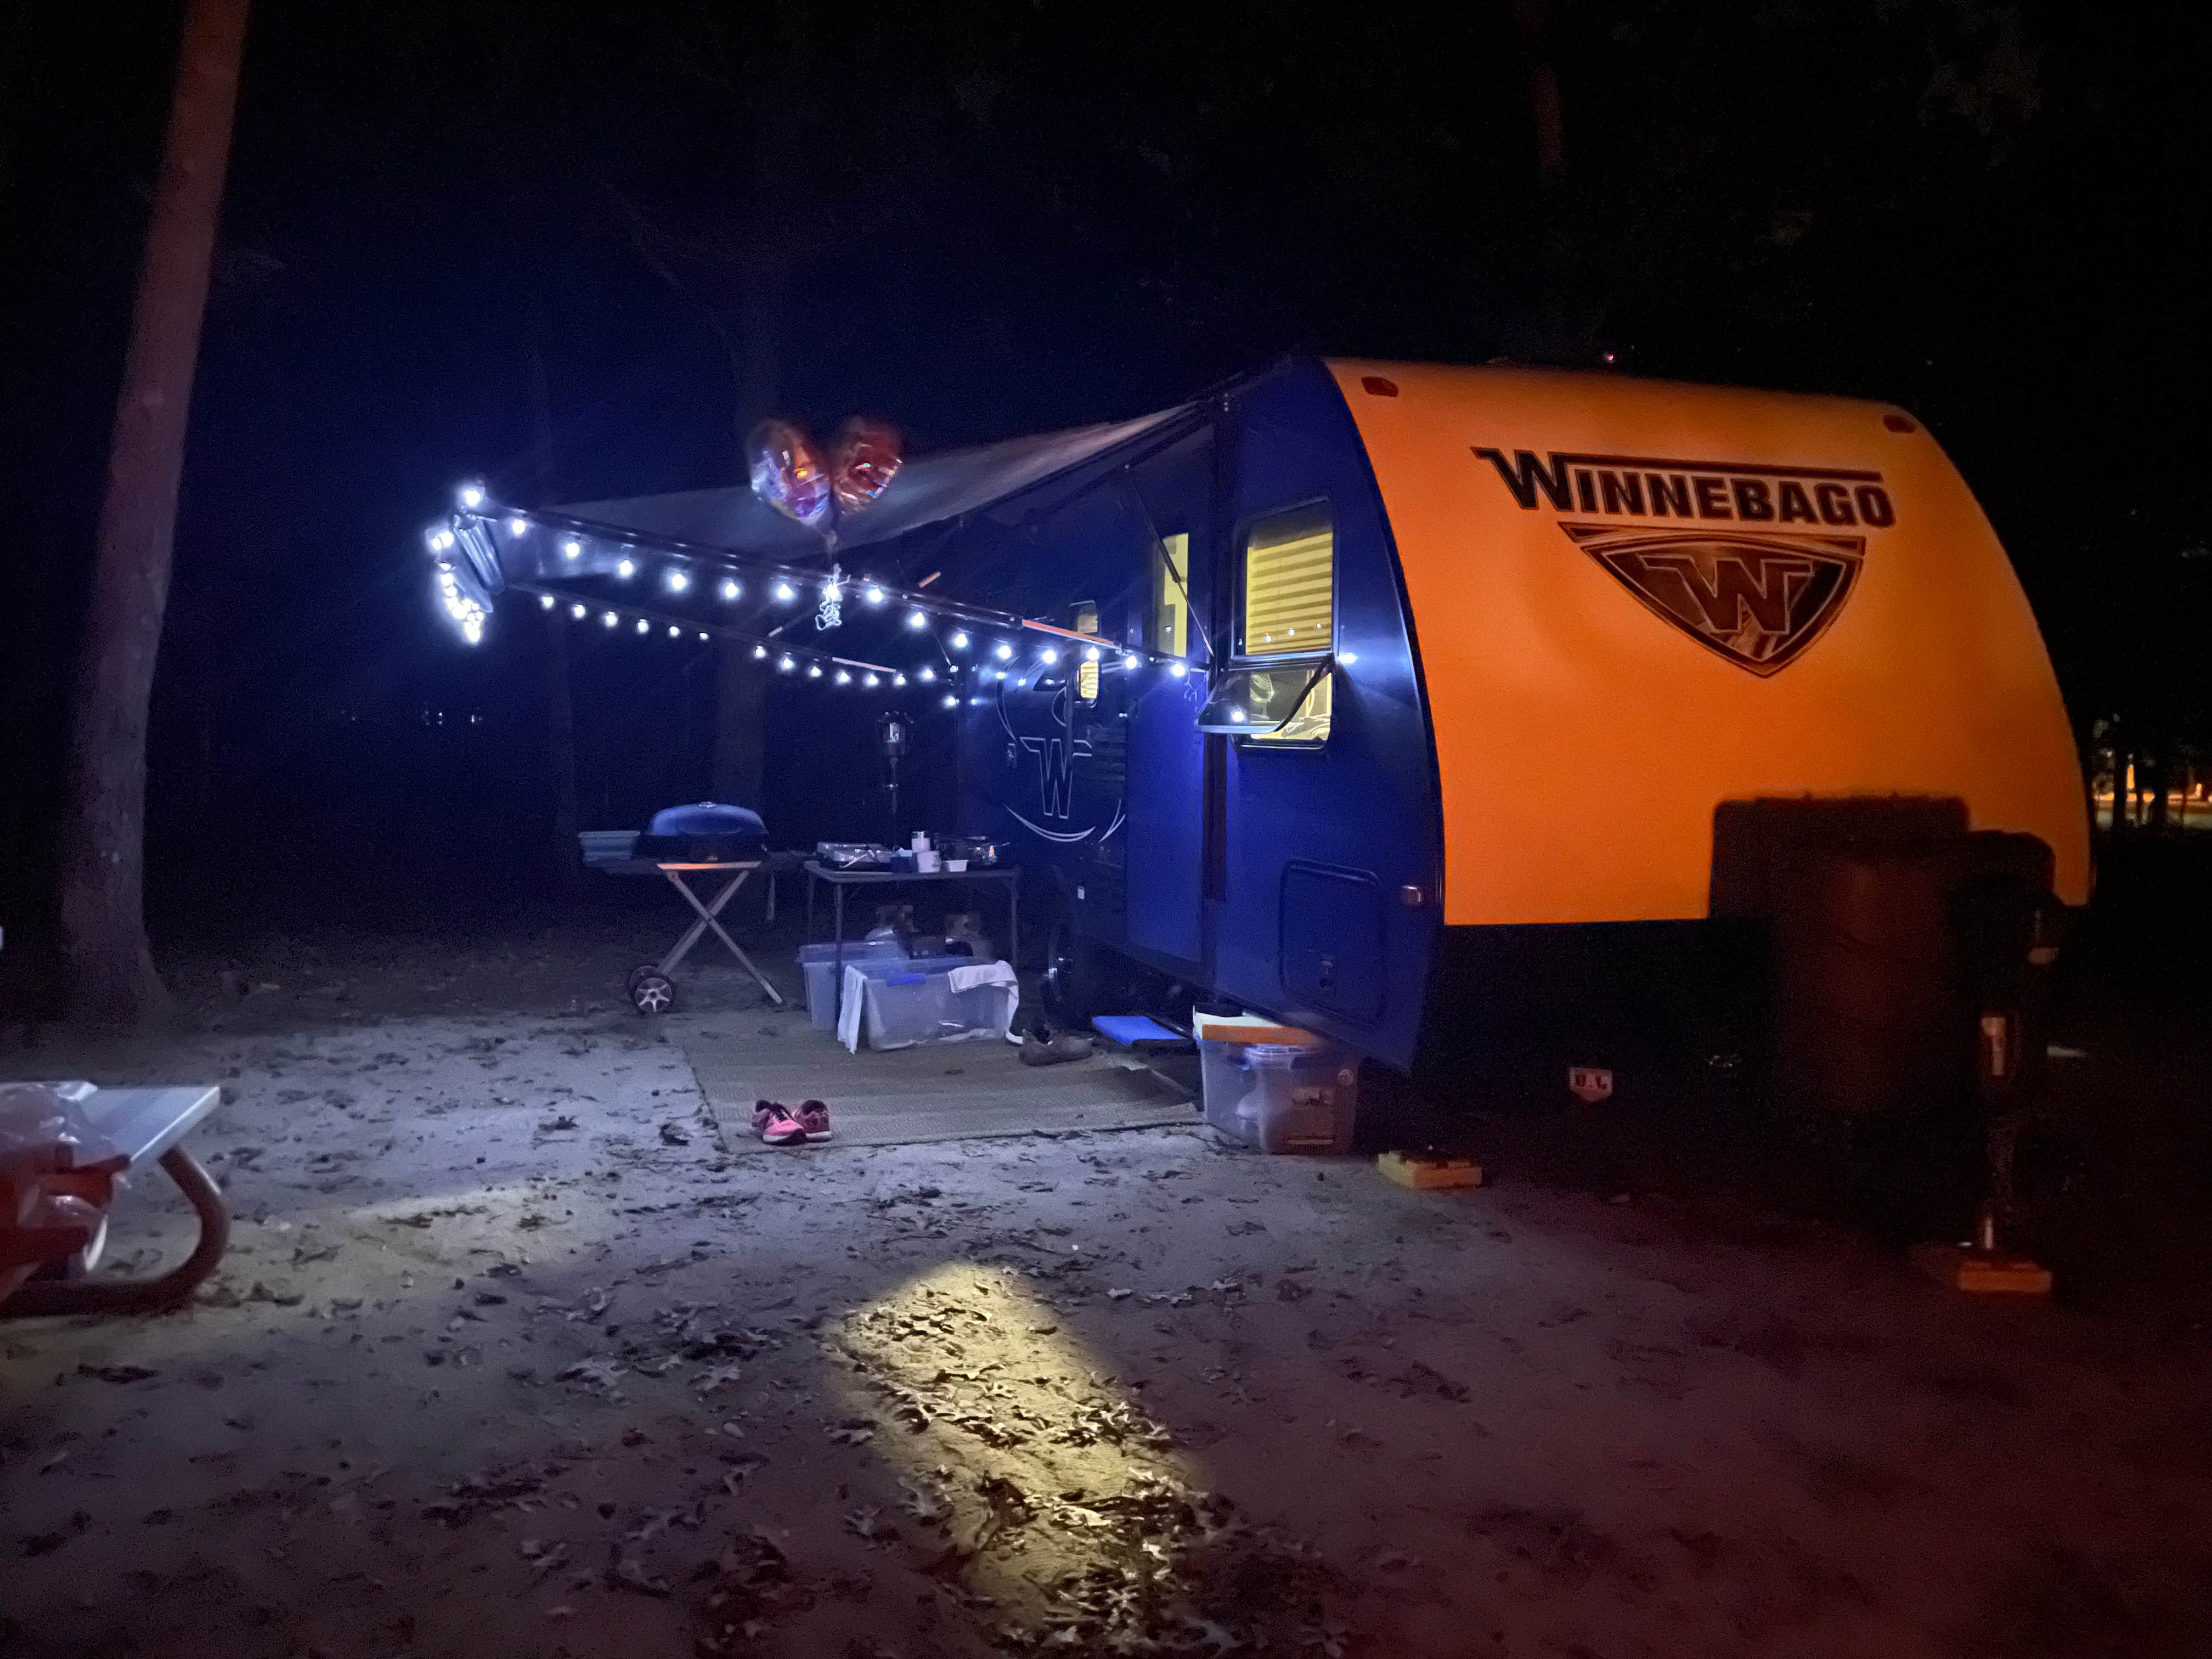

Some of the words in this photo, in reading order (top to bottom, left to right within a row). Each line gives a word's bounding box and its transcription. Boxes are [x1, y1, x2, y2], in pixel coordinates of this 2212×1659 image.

[1470, 447, 1896, 528] WINNEBAGO
[1639, 554, 1813, 634] W
[1019, 736, 1092, 819] W
